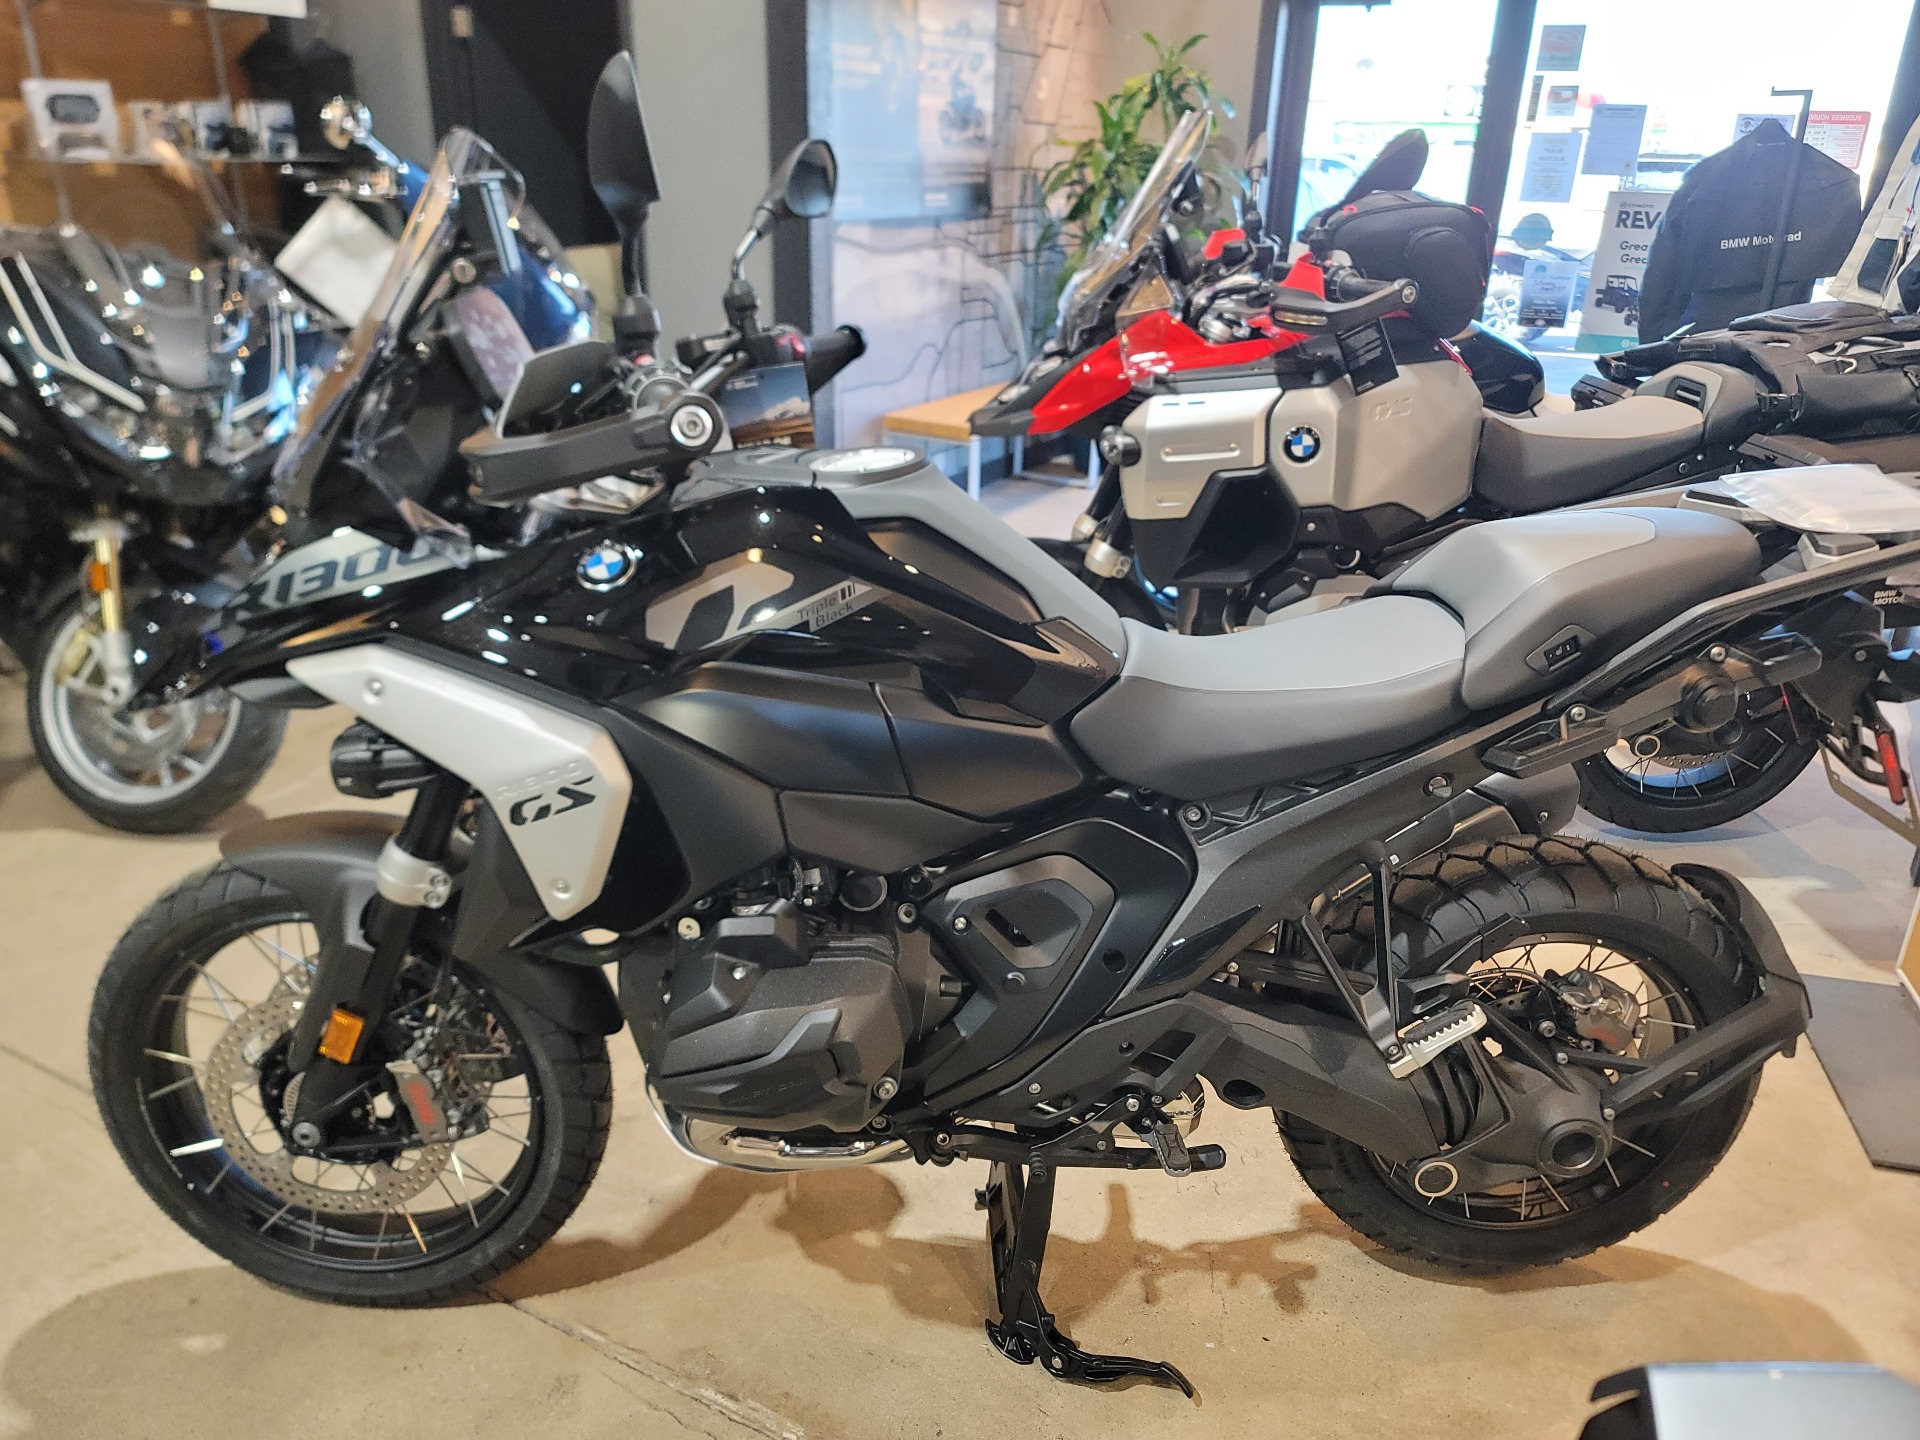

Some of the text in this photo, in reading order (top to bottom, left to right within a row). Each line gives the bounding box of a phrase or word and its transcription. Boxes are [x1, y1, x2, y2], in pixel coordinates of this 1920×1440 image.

[1615, 209, 1662, 230] REV
[1720, 231, 1802, 250] BMW Motad
[1874, 589, 1898, 599] BMW
[796, 596, 837, 621] Triple
[815, 601, 855, 628] Black
[508, 775, 597, 827] GS
